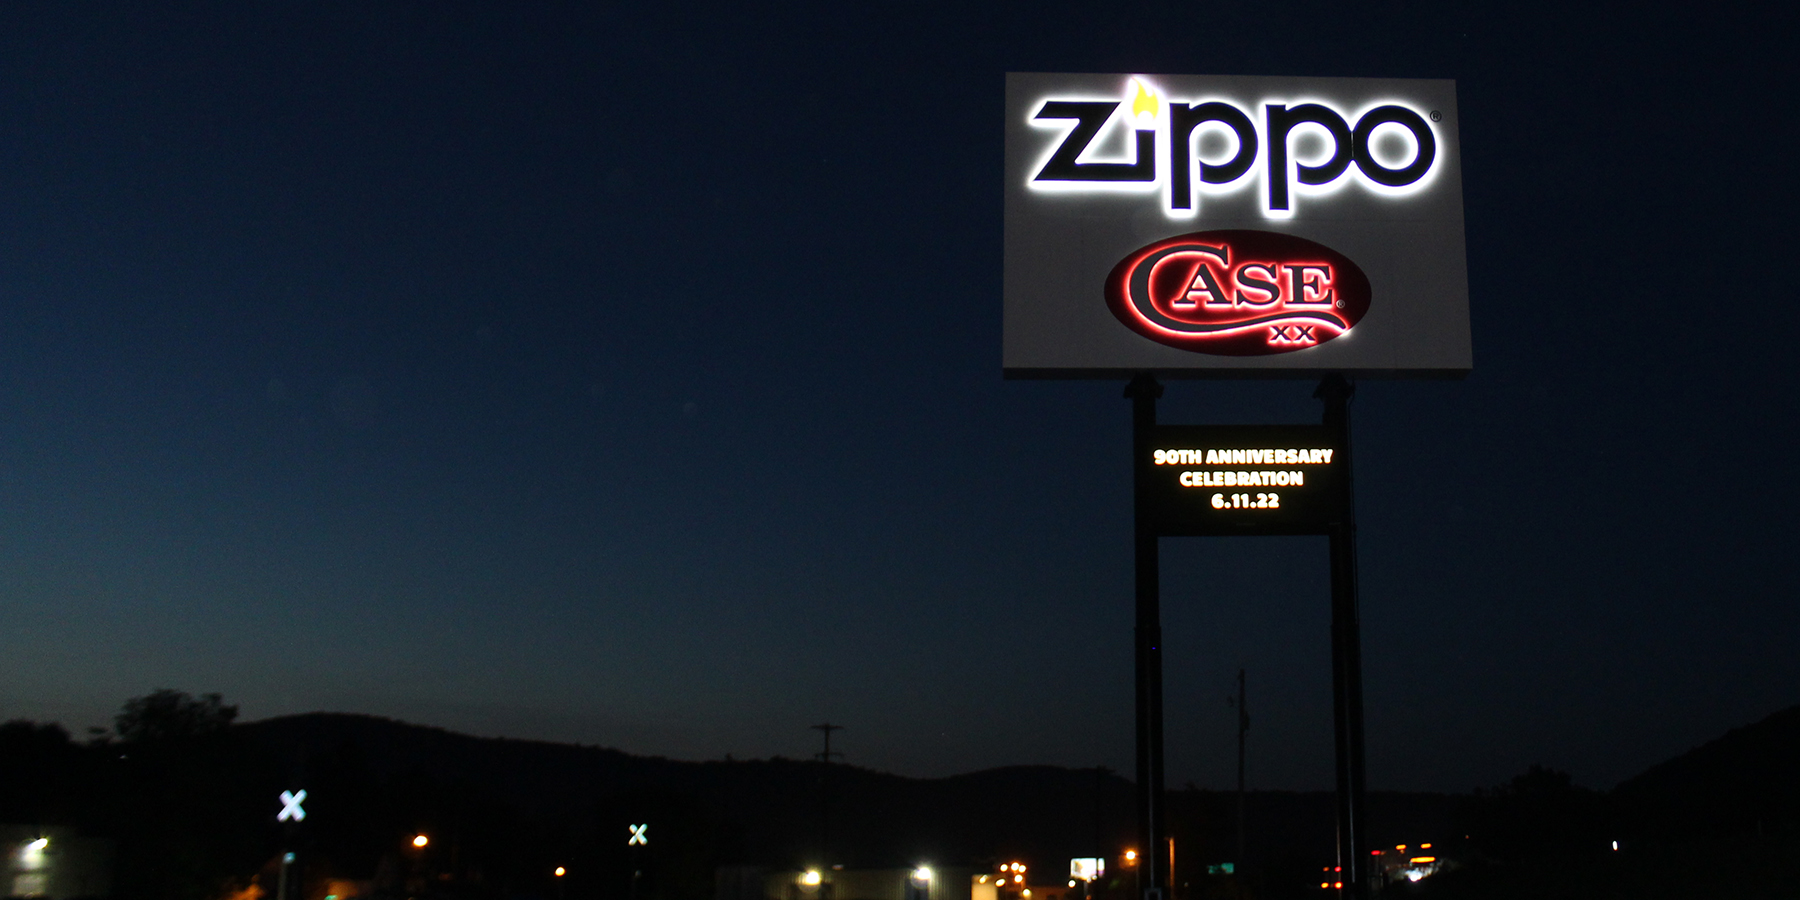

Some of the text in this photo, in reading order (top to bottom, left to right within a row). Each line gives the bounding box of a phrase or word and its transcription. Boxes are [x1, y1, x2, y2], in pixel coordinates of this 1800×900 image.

[1128, 242, 1347, 332] CASE
[1269, 326, 1315, 344] XX
[1153, 449, 1333, 465] 90TH ANNIVERSARY
[1179, 471, 1304, 487] CELEBRATION
[1211, 493, 1280, 509] 6.11.22
